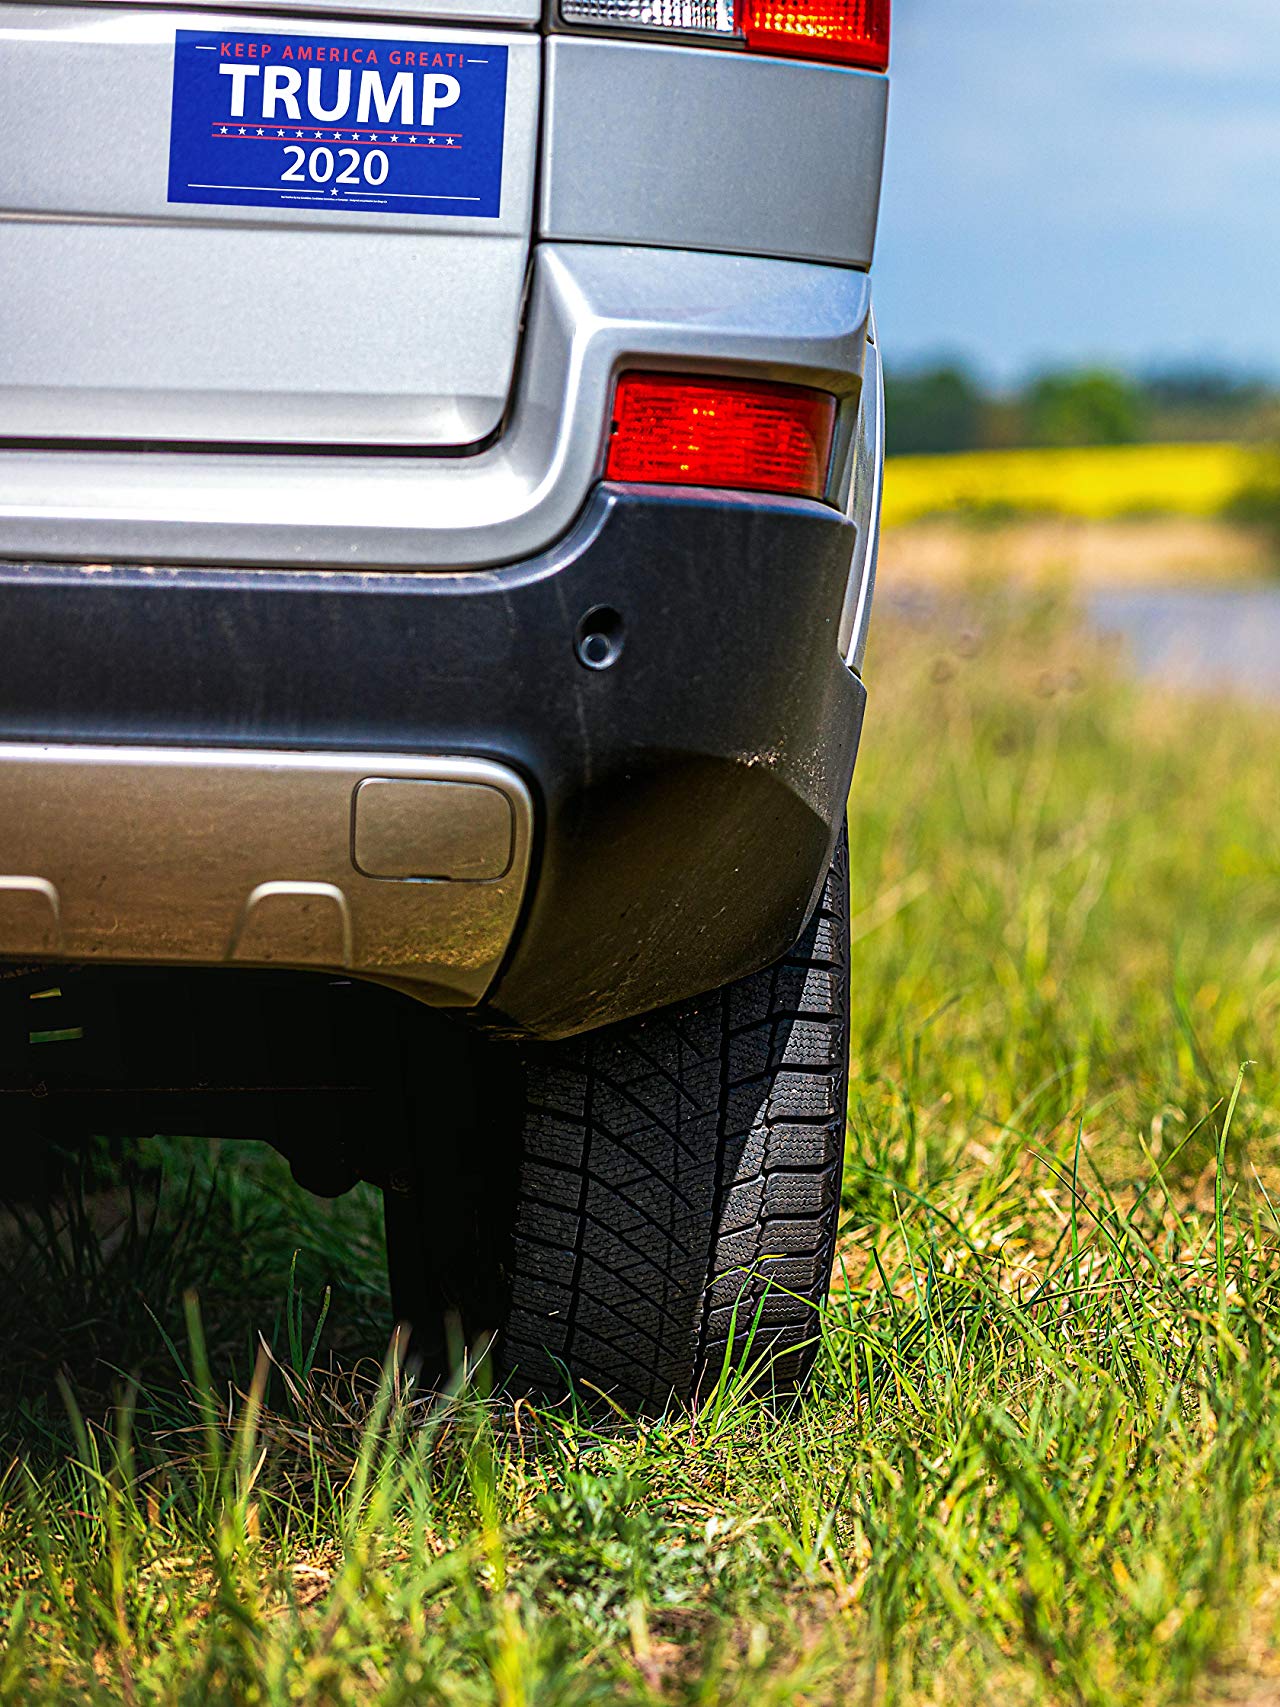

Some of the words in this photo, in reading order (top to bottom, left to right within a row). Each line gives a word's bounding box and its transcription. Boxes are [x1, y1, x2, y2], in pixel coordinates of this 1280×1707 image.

[221, 43, 271, 58] KEEP
[282, 46, 377, 63] AMERICA
[389, 51, 463, 67] GREAT!
[219, 63, 461, 126] TRUMP
[281, 146, 388, 185] 2020
